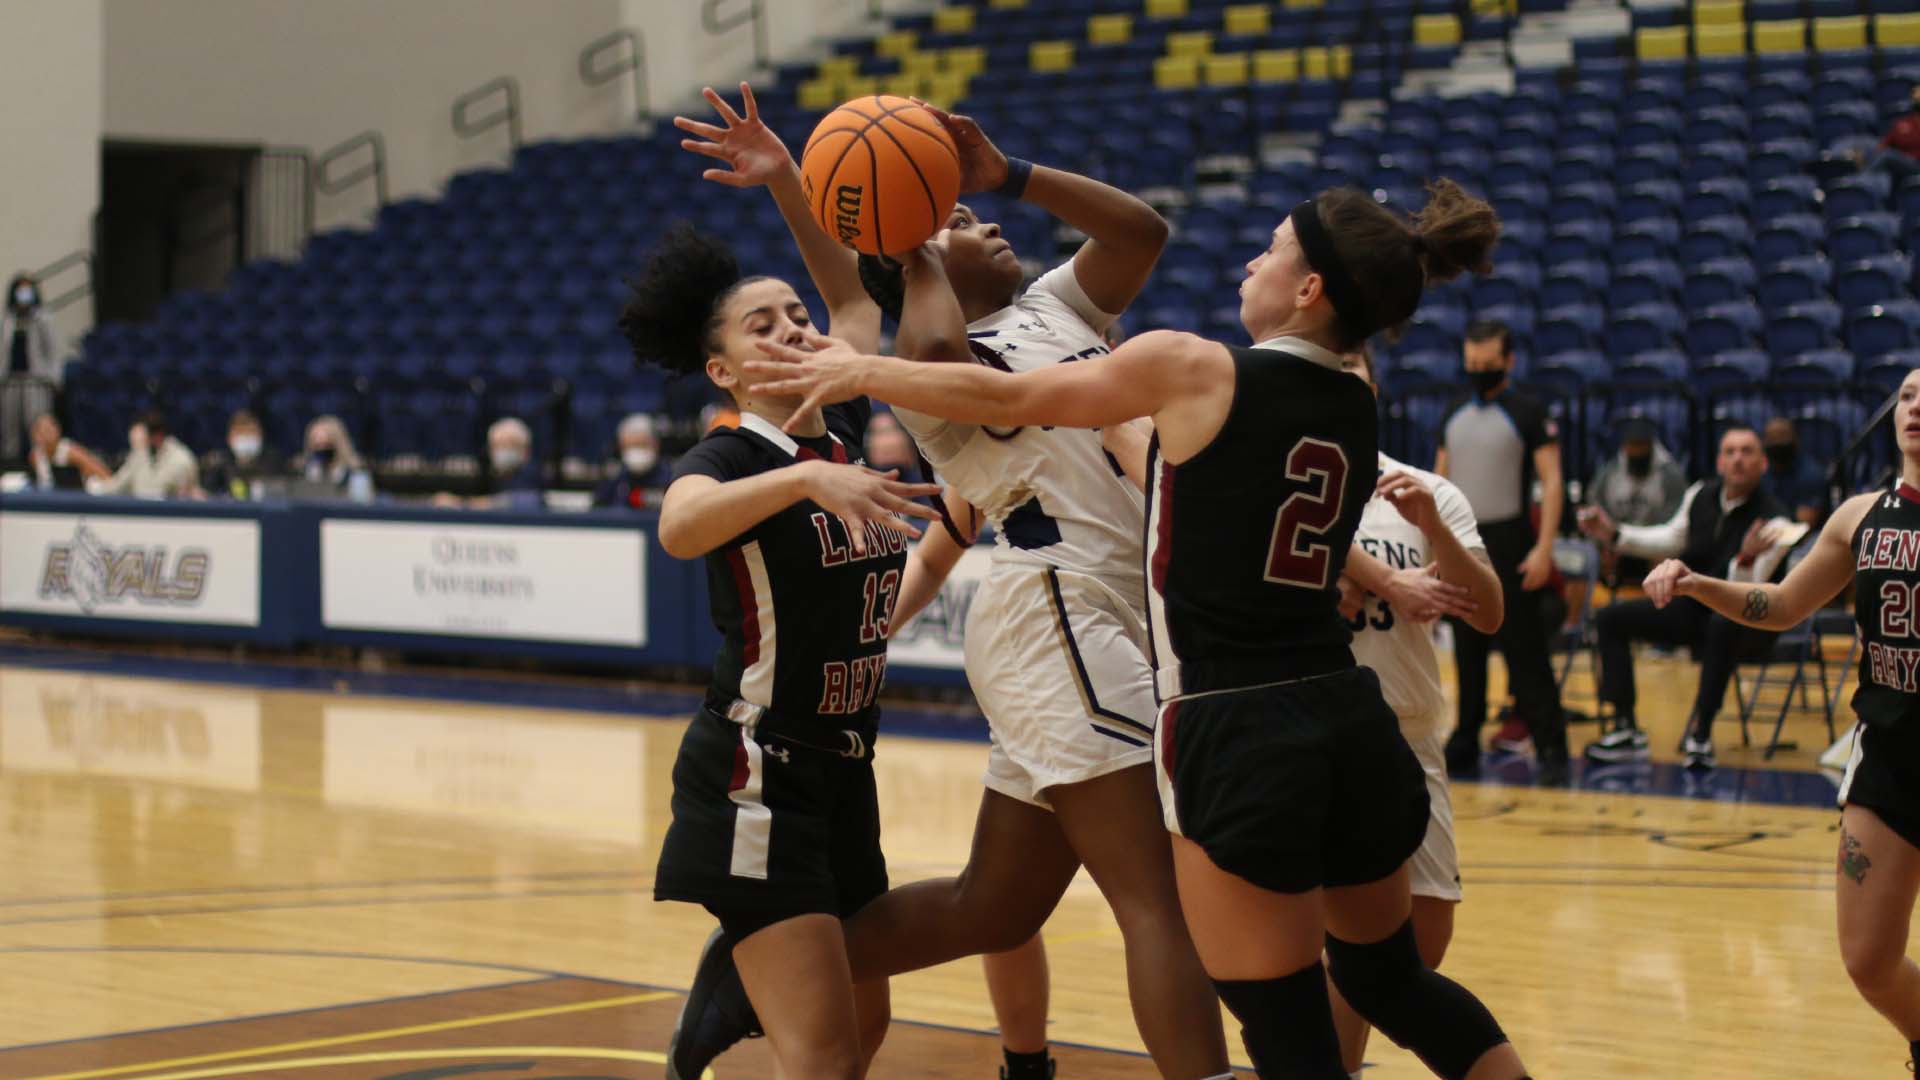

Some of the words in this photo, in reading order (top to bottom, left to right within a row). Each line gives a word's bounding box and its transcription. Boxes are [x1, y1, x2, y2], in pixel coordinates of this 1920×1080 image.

[1264, 436, 1349, 589] 2
[38, 542, 212, 606] RYALS
[1857, 528, 1920, 571] LEN
[860, 569, 899, 644] 13
